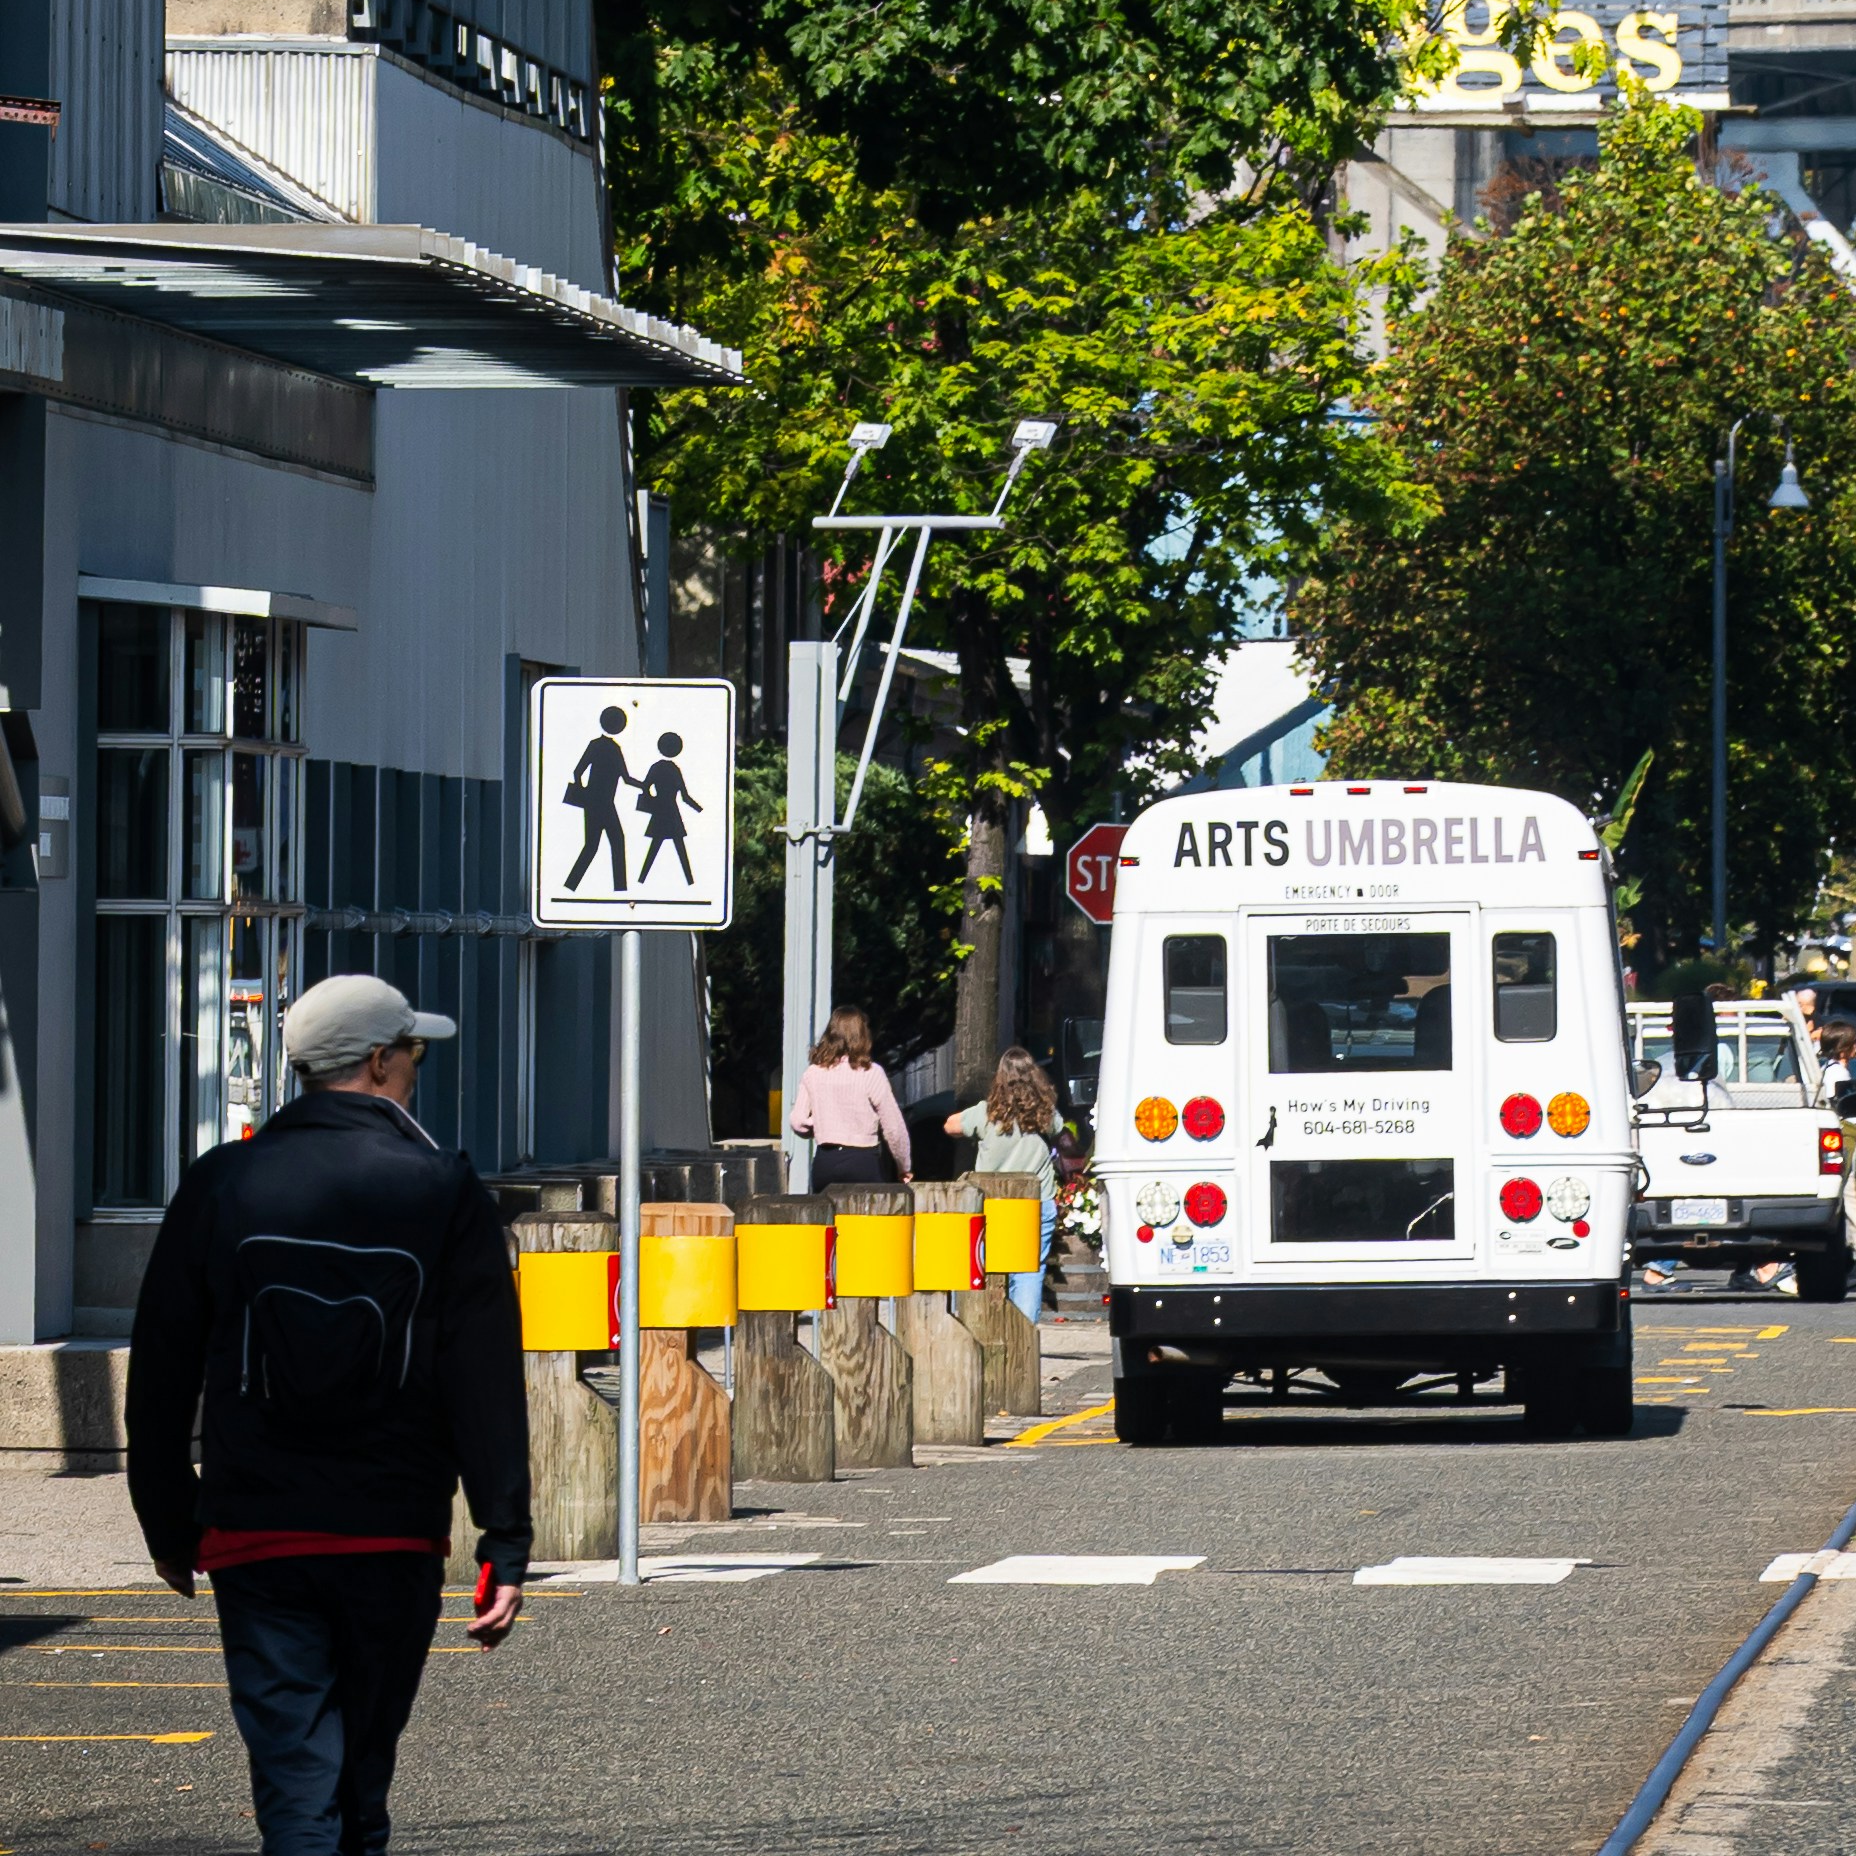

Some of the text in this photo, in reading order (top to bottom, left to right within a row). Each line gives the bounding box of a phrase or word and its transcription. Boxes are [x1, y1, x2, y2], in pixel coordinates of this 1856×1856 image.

[1173, 816, 1547, 868] ARTS UMBRELLA
[1075, 855, 1113, 892] ST
[1285, 884, 1399, 899] EMERGENCY DOOR
[1306, 918, 1411, 931] PORTE DE SECOURS
[1288, 1098, 1430, 1114] How's My Driving
[1303, 1119, 1415, 1135] 604-681-5268
